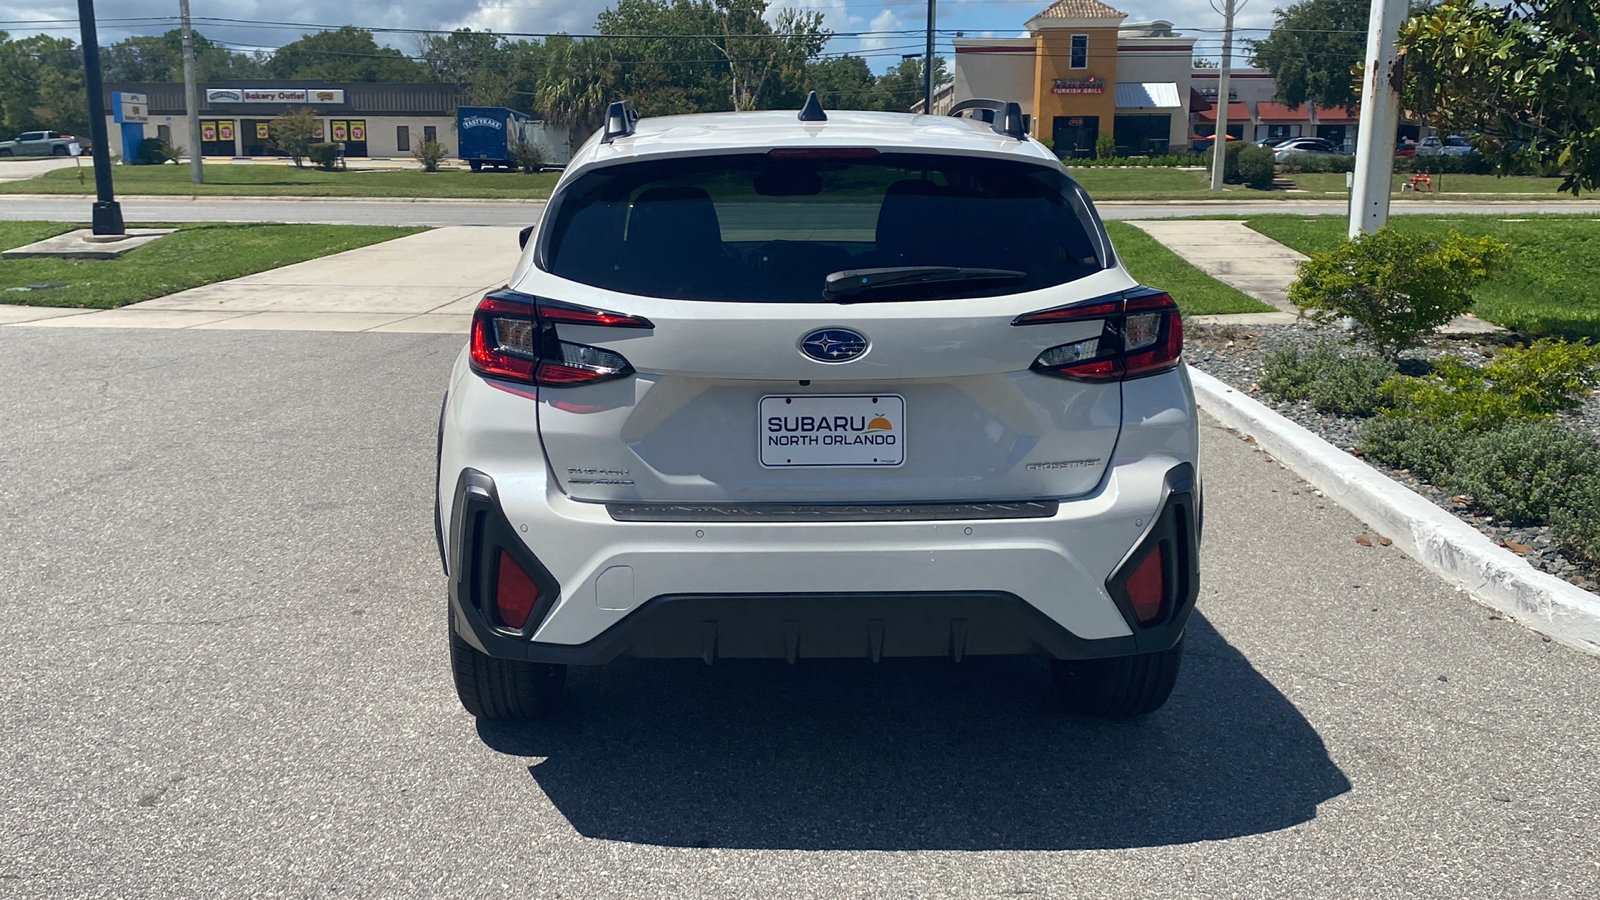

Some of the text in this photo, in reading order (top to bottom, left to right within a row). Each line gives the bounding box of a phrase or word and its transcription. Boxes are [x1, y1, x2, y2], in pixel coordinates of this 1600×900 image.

[245, 92, 305, 101] Bakery Outlet
[464, 119, 501, 129] TASTYKAKE
[768, 416, 866, 432] SUBARU
[768, 434, 896, 446] NORTH ORLANDO
[1025, 457, 1101, 471] CROSSTREK
